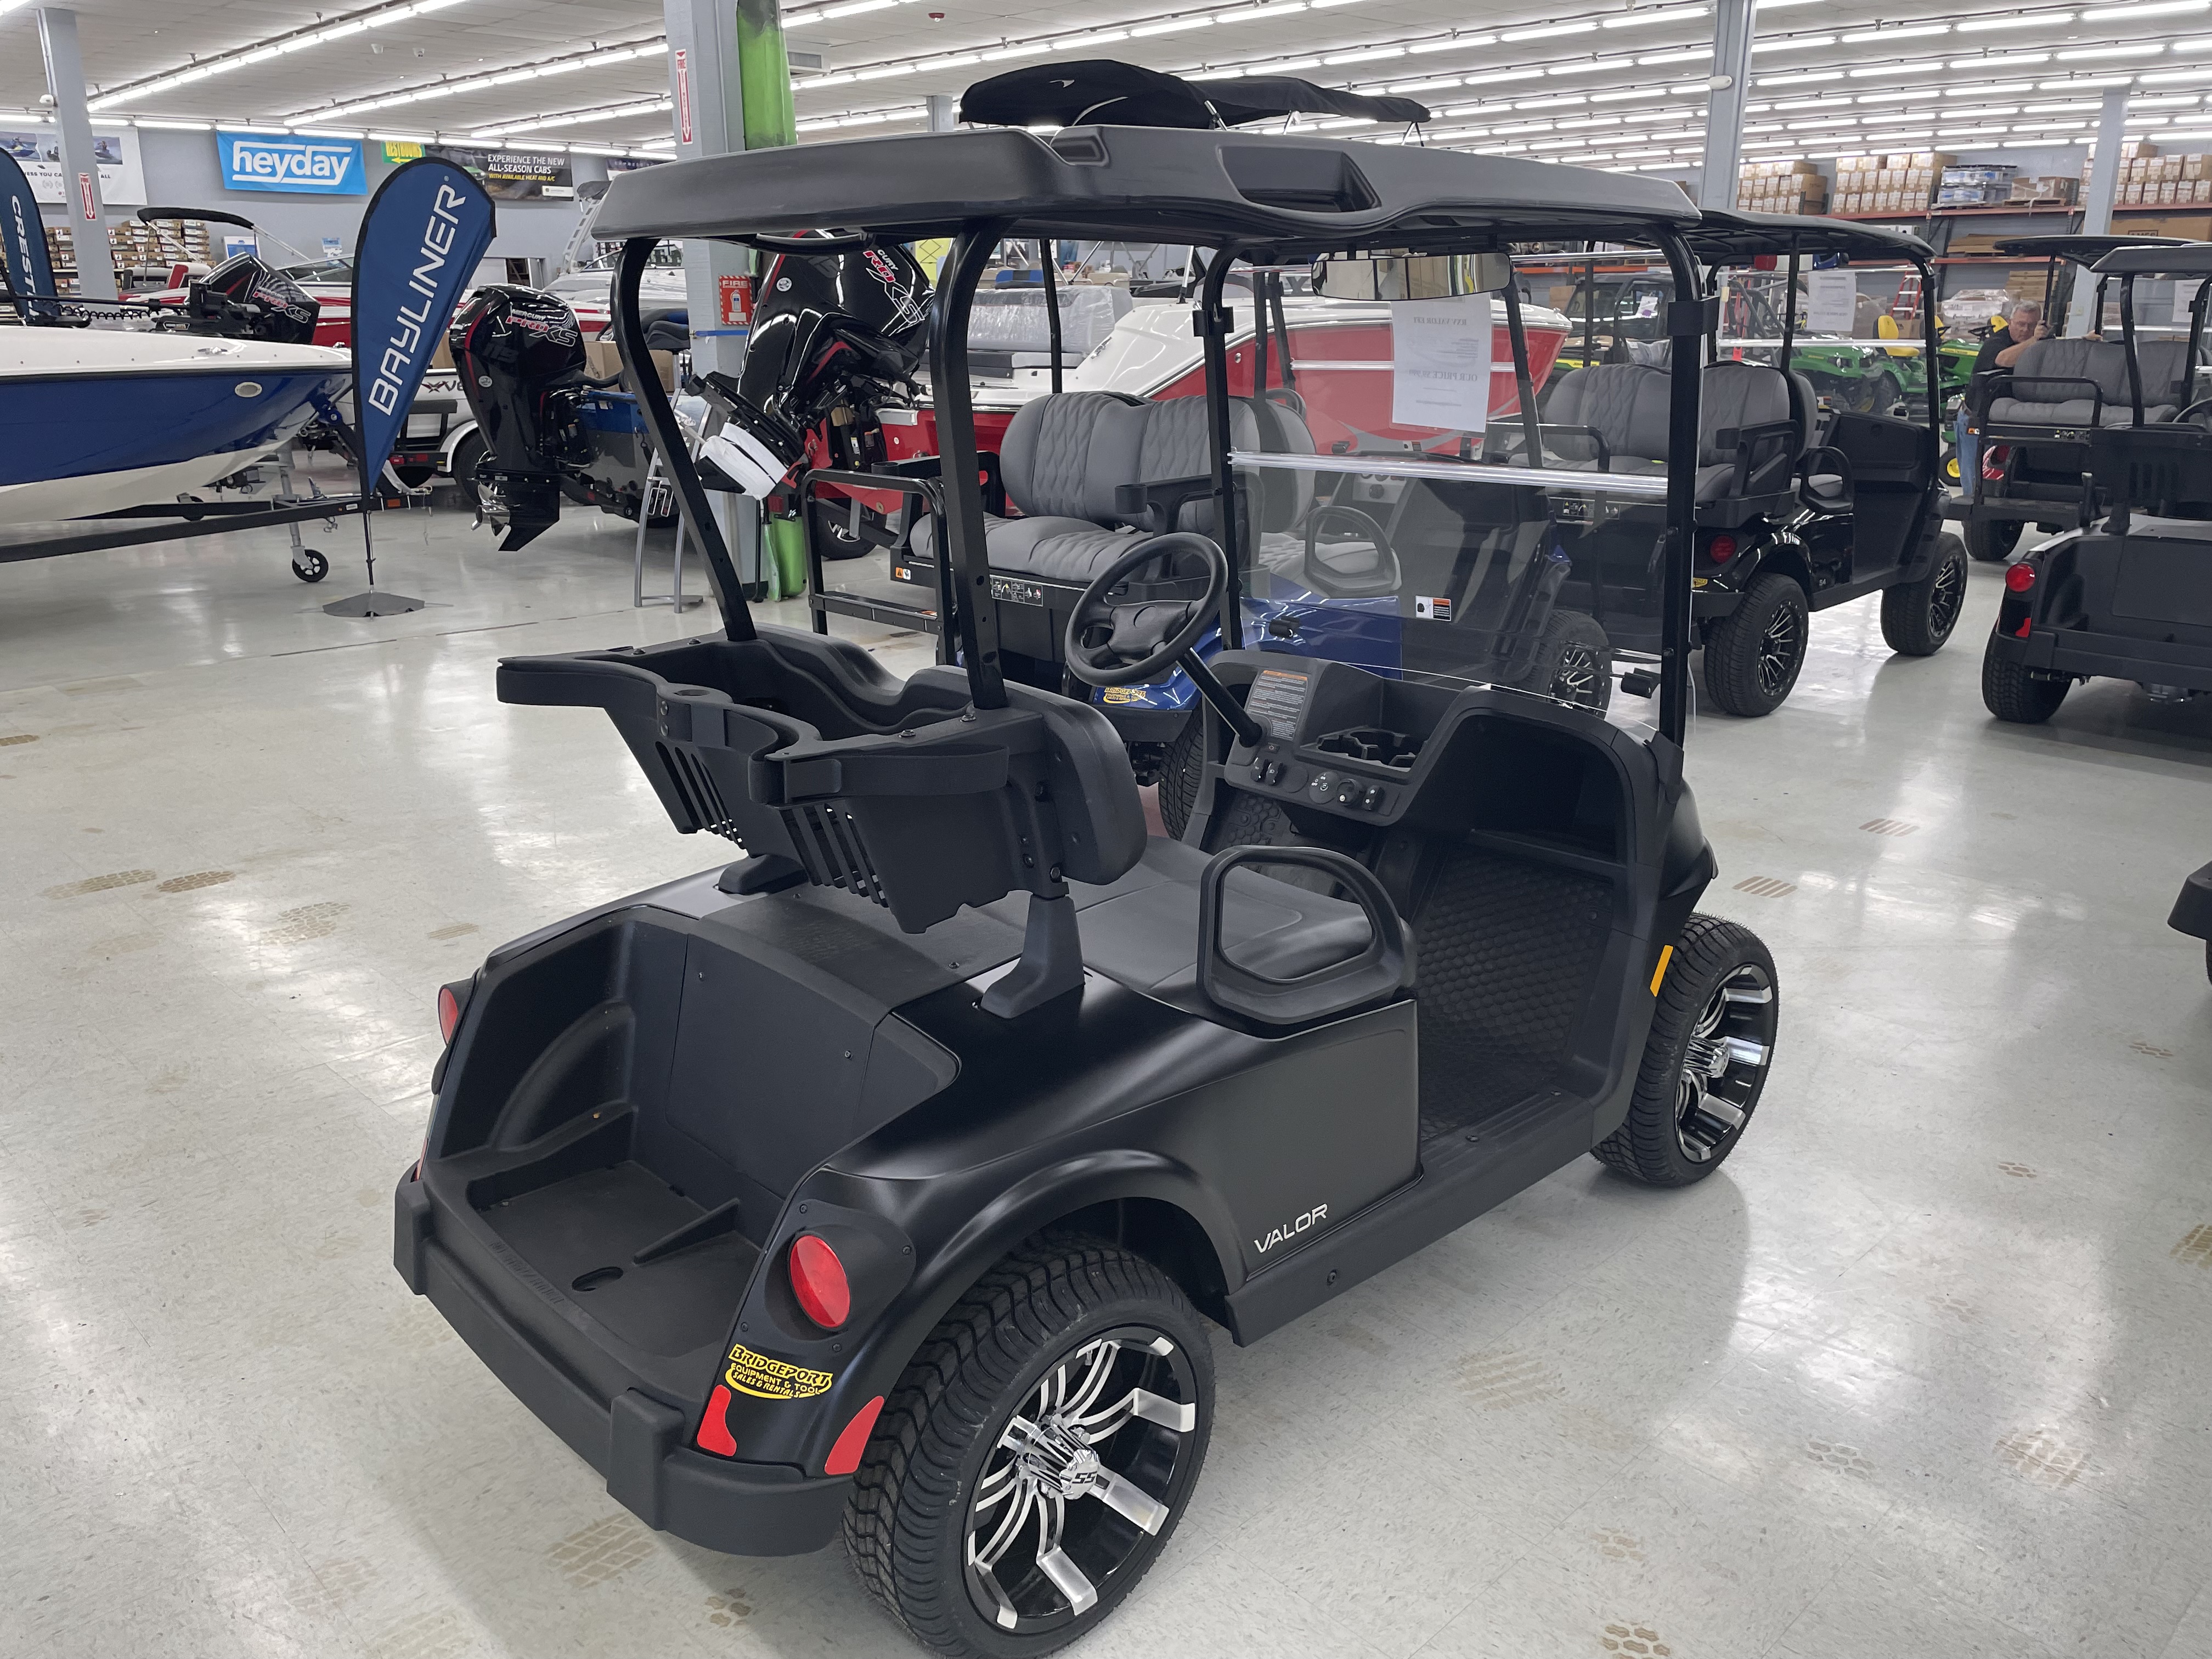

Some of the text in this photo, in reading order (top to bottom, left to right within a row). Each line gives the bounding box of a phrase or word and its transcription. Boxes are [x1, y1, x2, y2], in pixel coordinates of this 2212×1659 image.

[232, 141, 353, 185] heyday
[487, 154, 565, 166] EXPERIENCE THE NEW
[488, 163, 551, 174] ALL-SEASON CABS
[368, 184, 466, 416] BAYLINER
[505, 315, 549, 332] PRO
[511, 308, 546, 321] MERCURY
[529, 326, 578, 347] XS
[1254, 1203, 1328, 1253] VALOR
[729, 1344, 833, 1386] BRIDGEPORT
[731, 1362, 782, 1385] EQUIPMENT
[794, 1383, 821, 1395] TOOL
[732, 1372, 757, 1386] SALES
[763, 1383, 801, 1398] RENTALS
